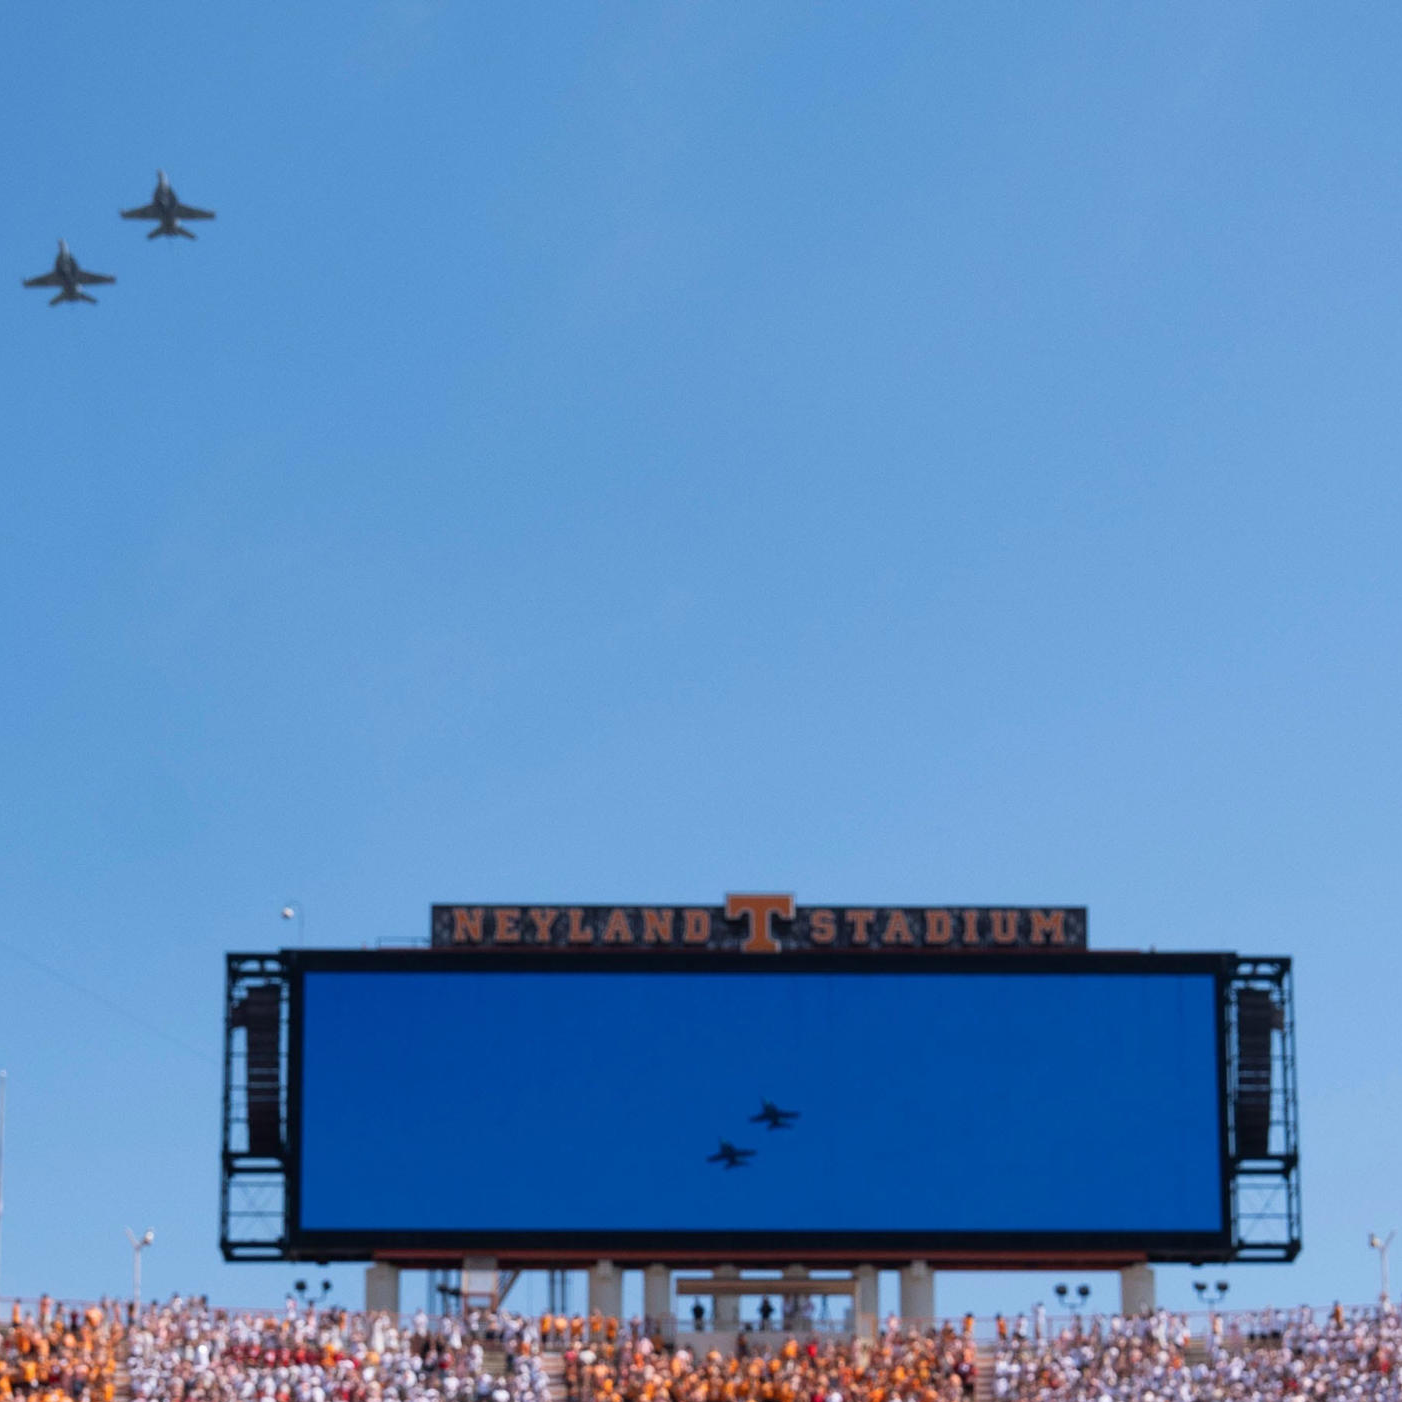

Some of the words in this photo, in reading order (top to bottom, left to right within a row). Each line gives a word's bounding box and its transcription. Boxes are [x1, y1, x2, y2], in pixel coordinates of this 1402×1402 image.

[451, 907, 711, 944] NEYLAND
[725, 893, 795, 953] T
[809, 908, 1080, 944] STADIUM
